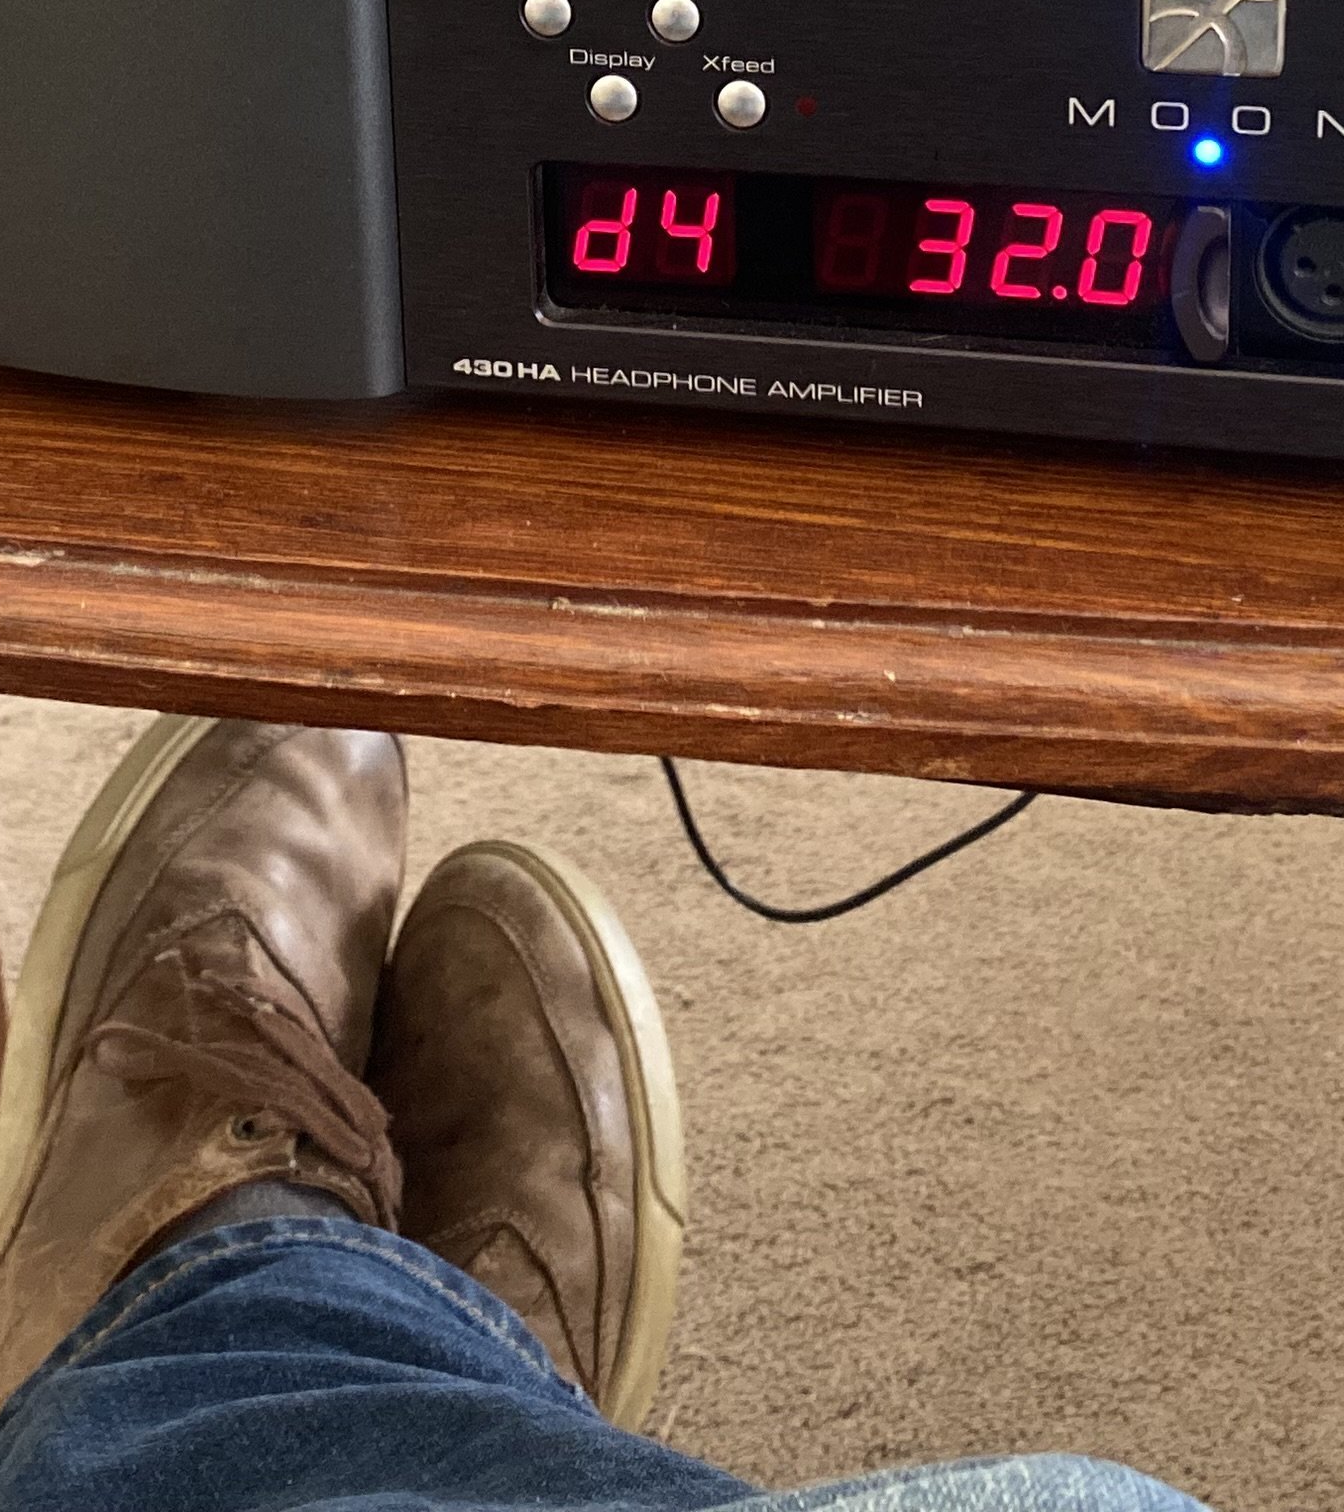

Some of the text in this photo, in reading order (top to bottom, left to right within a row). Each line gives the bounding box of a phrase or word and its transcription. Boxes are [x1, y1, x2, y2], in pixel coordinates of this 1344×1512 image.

[569, 49, 656, 71] Display
[702, 55, 775, 74] Xfeed
[574, 188, 1152, 305] d4 32.0
[571, 366, 757, 395] HEADPHONE
[768, 381, 923, 409] AMPLIFIER
